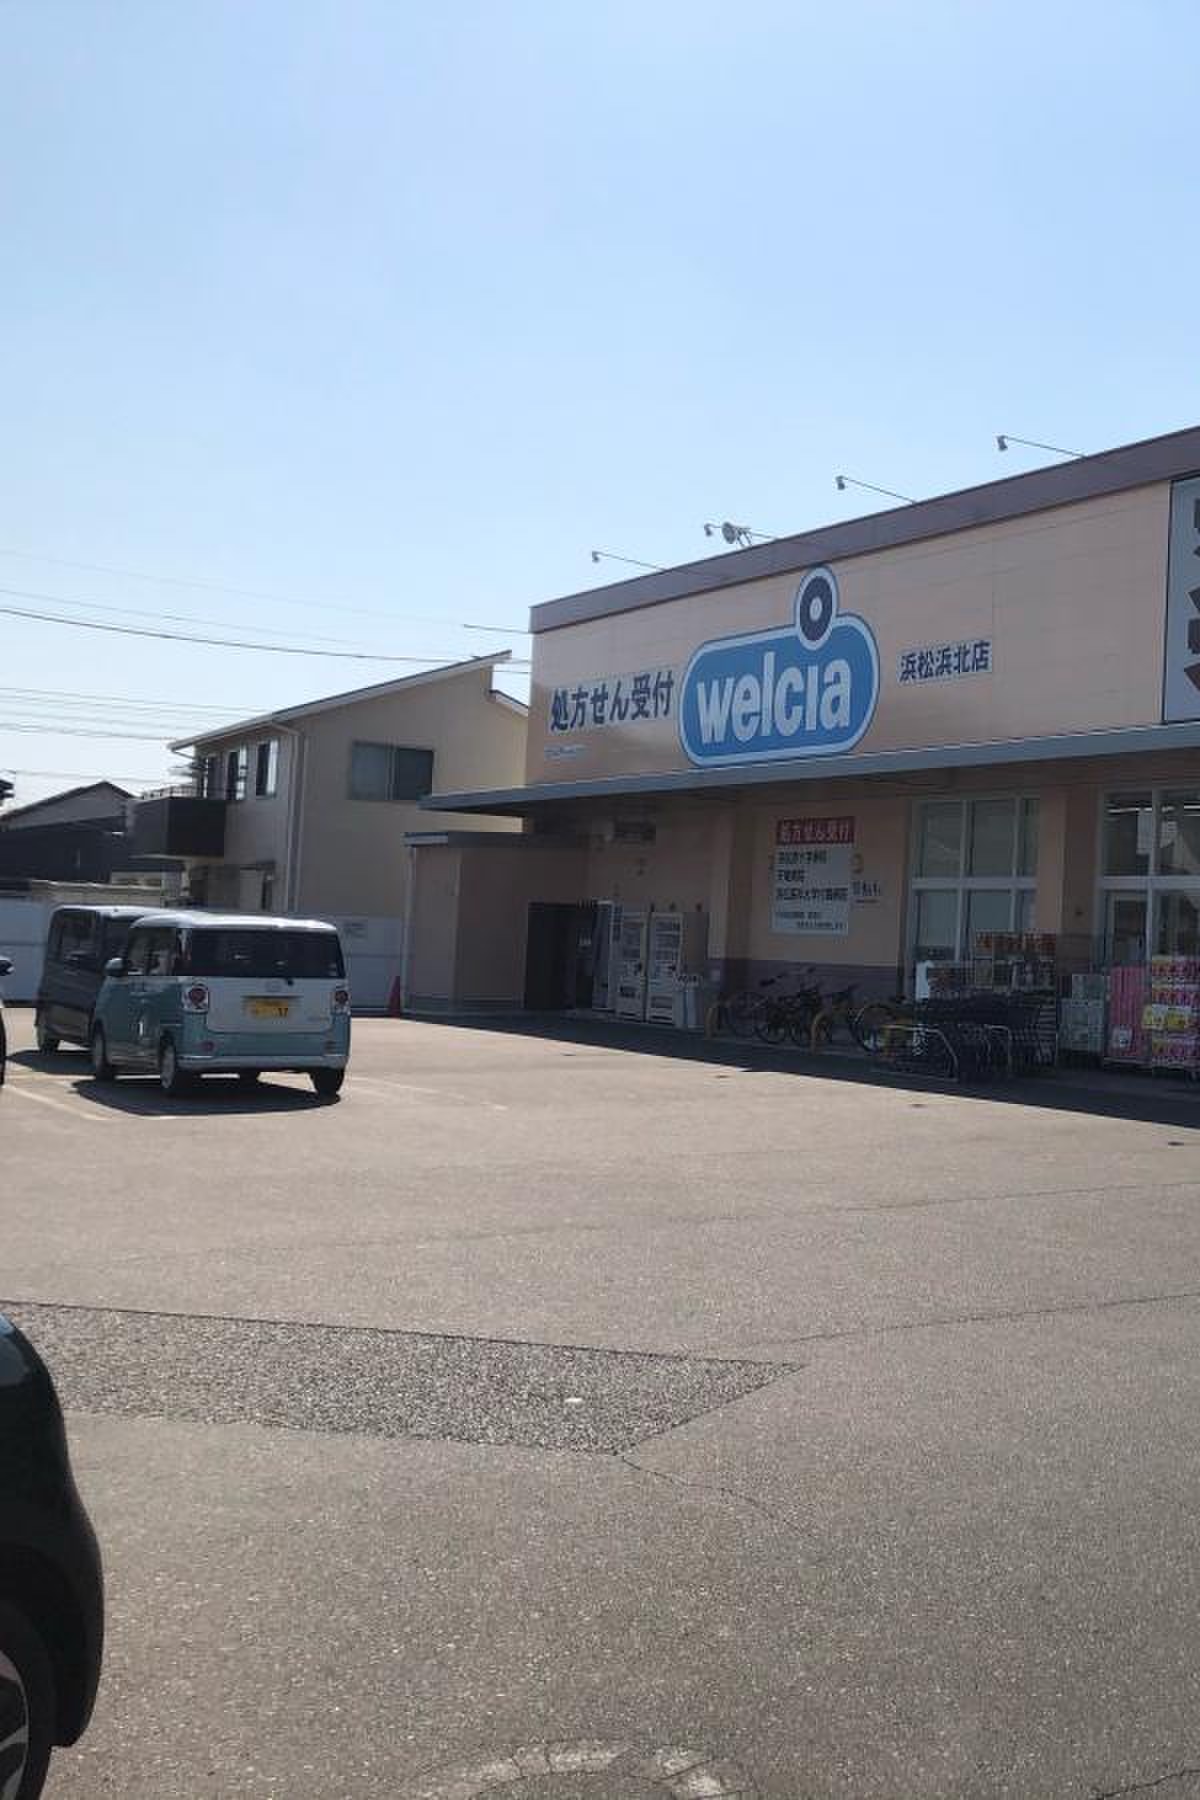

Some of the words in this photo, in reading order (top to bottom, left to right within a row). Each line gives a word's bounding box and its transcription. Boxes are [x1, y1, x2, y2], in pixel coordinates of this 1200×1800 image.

[899, 641, 990, 682] 浜松浜北店
[550, 671, 674, 732] 処方せん受付
[697, 651, 851, 744] welcia
